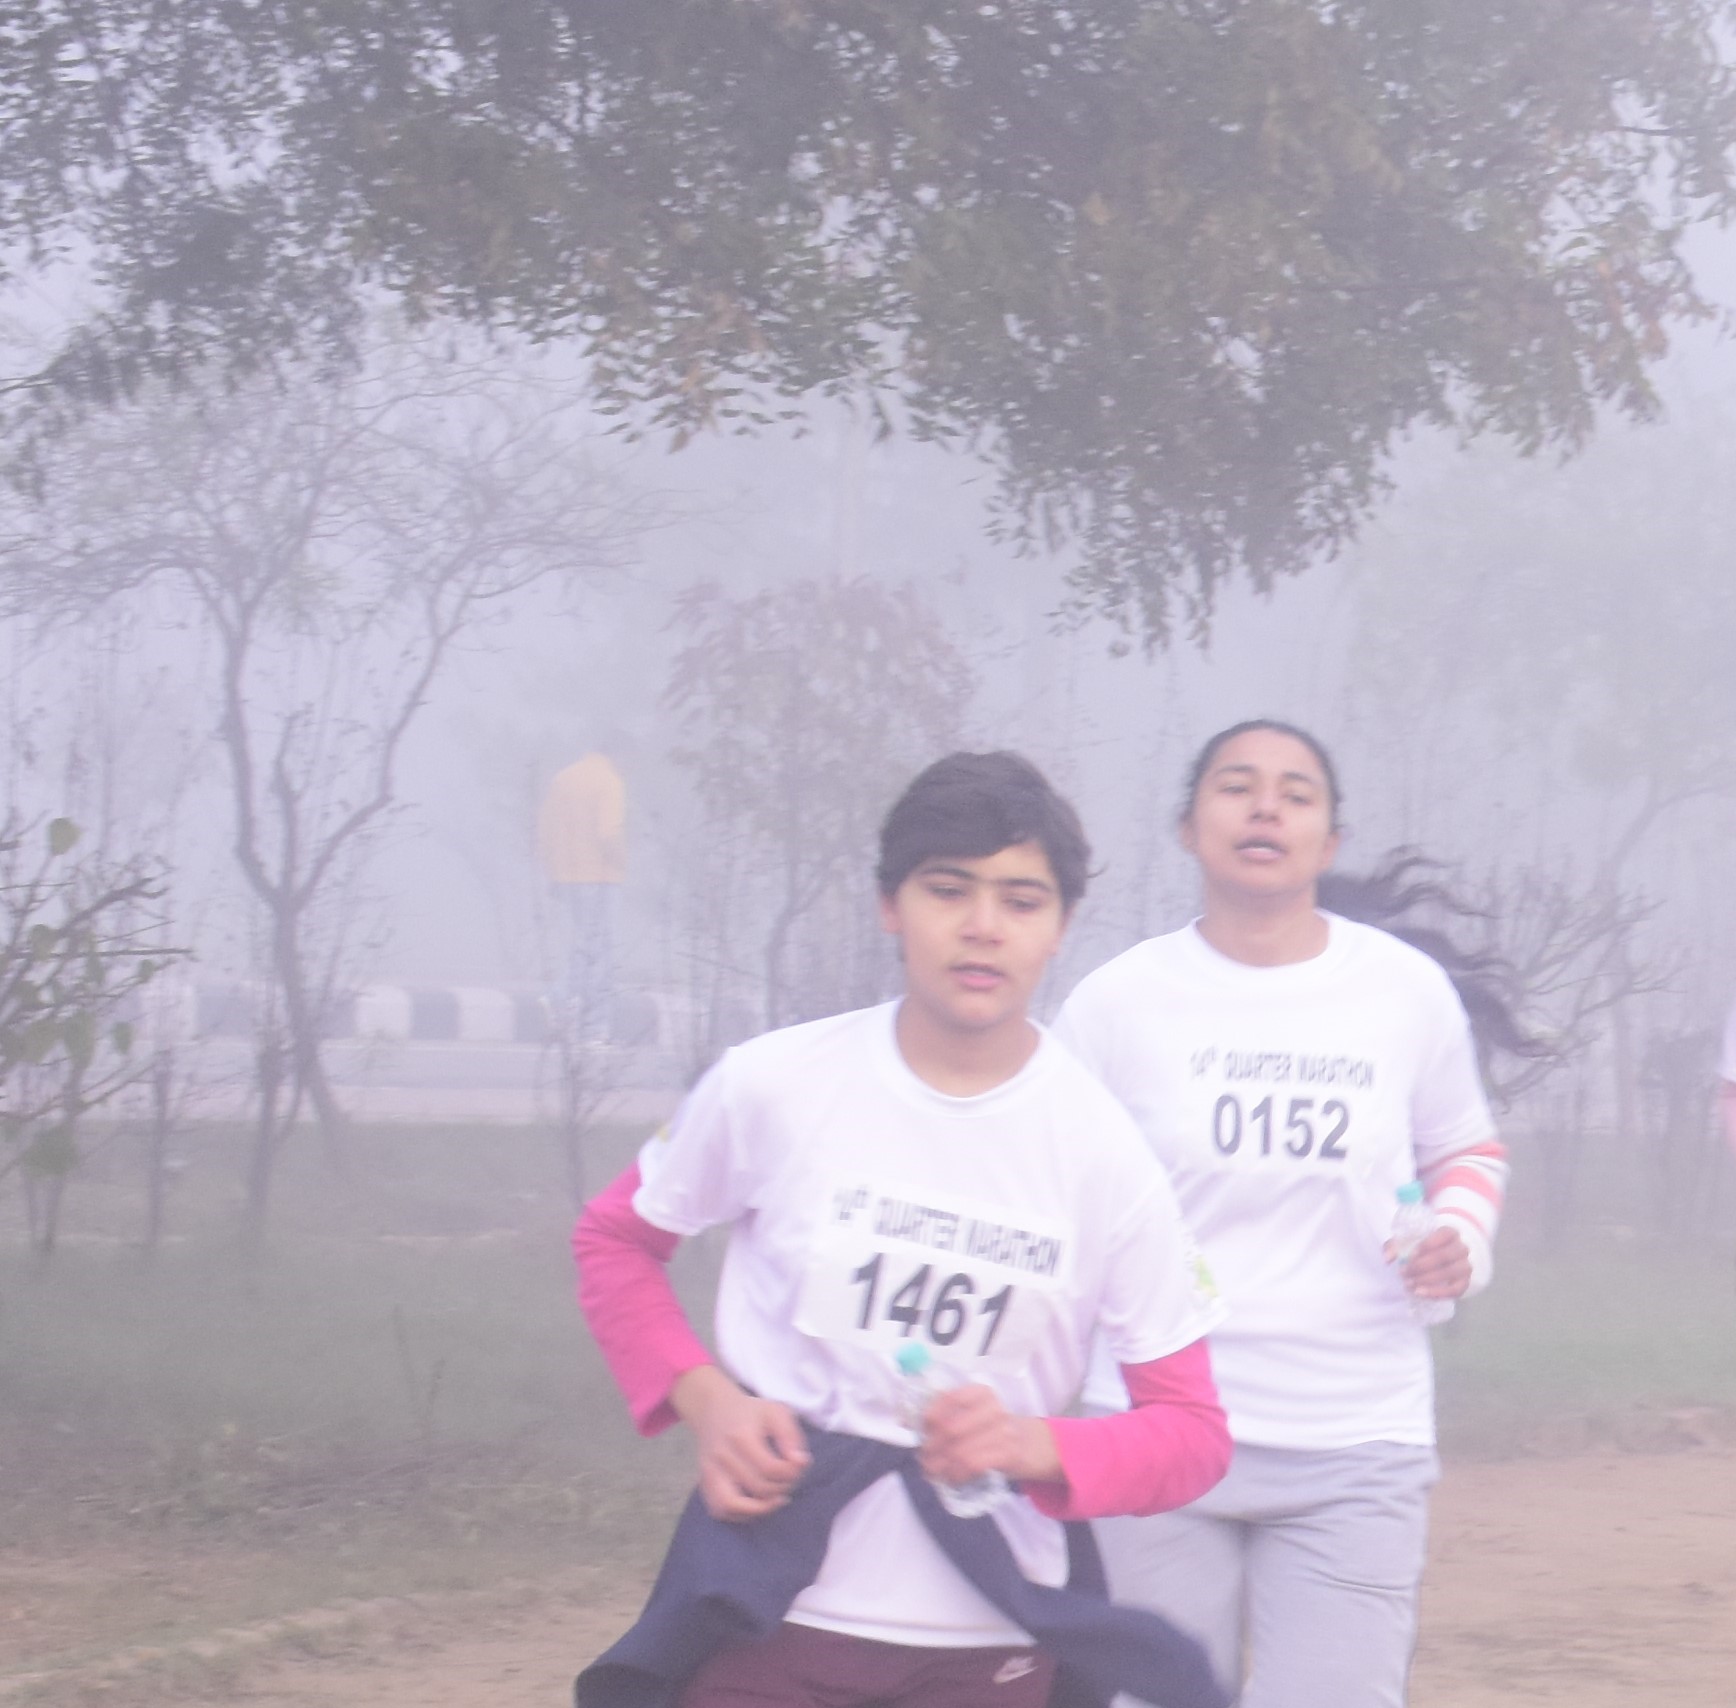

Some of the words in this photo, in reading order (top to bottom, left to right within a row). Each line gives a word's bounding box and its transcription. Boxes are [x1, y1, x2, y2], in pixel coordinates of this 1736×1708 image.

[1225, 1050, 1291, 1082] QUARTER
[1299, 1053, 1374, 1087] MARATHON
[1213, 1094, 1350, 1159] 0152
[873, 1195, 960, 1251] QUARTER
[966, 1217, 1063, 1277] MARATHON
[850, 1251, 1016, 1357] 1461
